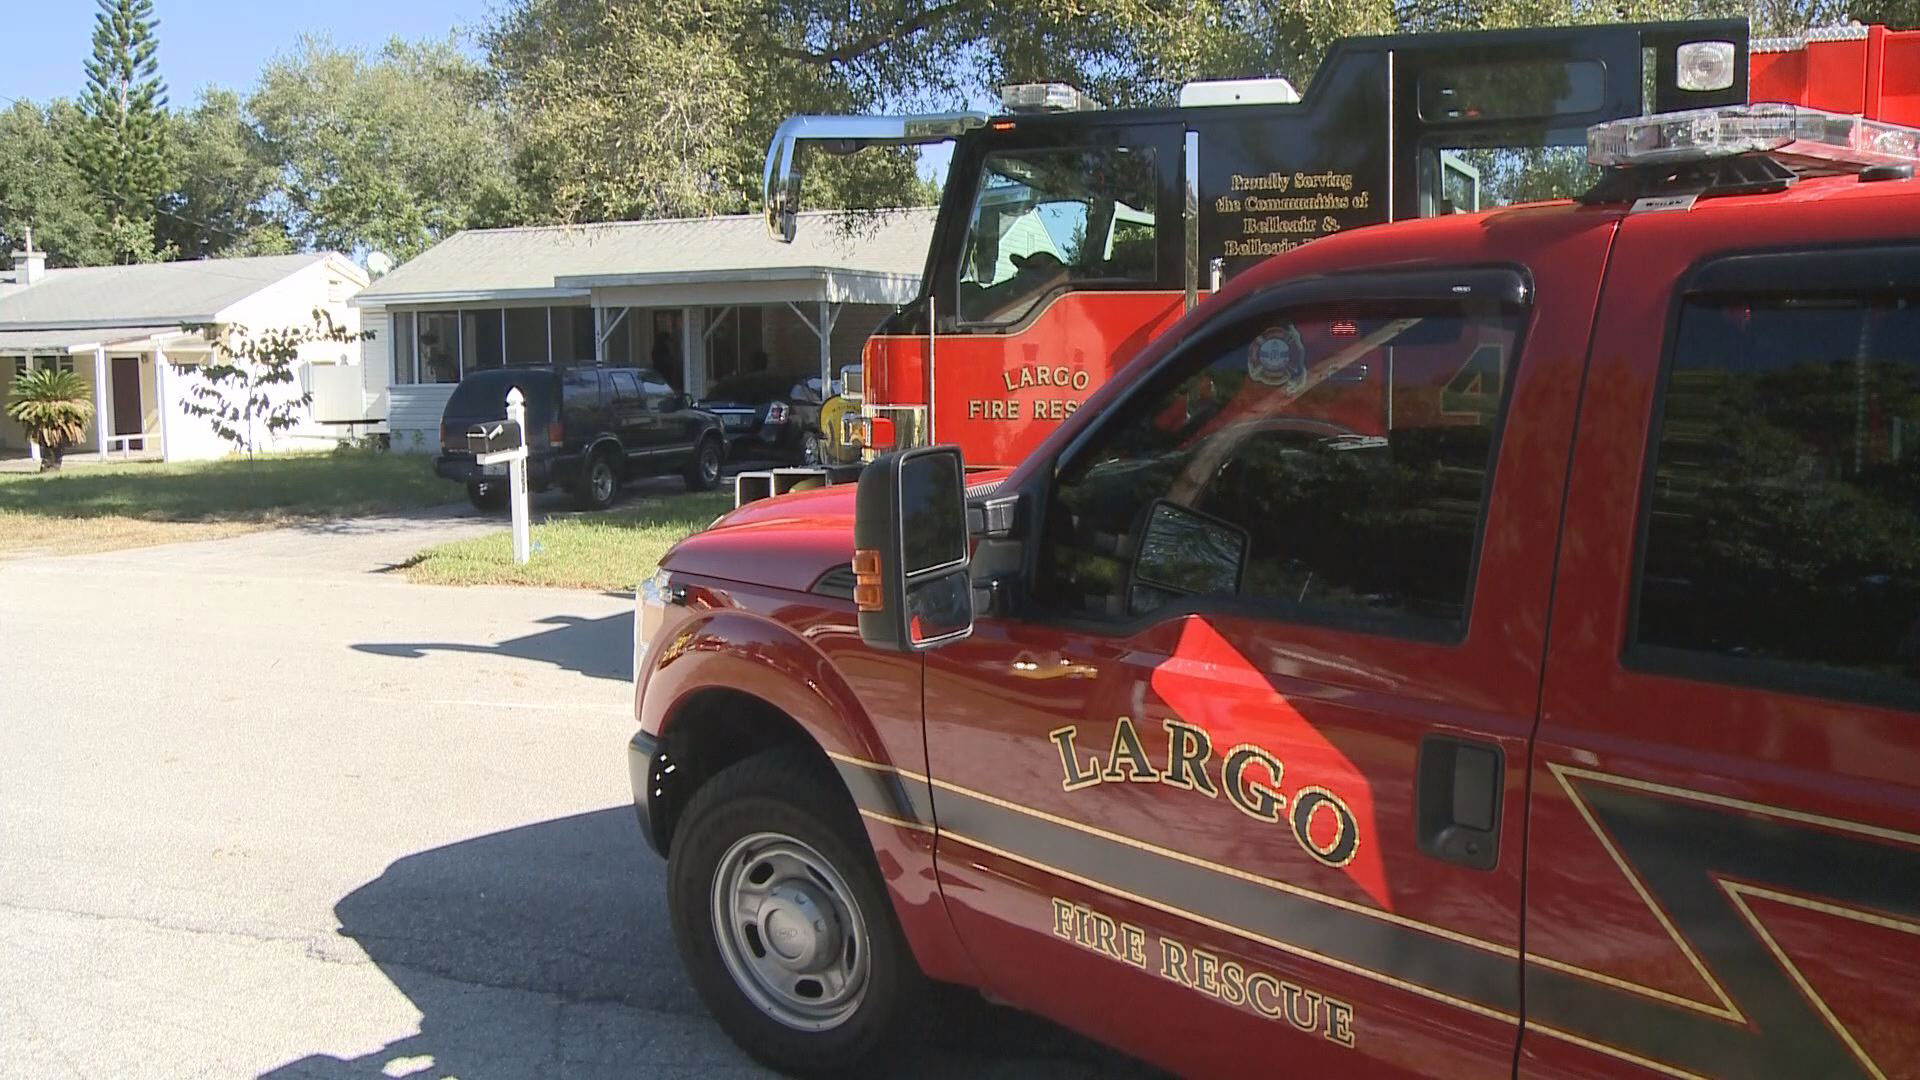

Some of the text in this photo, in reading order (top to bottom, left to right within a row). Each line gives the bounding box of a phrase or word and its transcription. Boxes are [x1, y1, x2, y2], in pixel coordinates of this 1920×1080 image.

[1231, 171, 1353, 192] Proudly Serving
[1216, 191, 1369, 212] the Communities of
[1243, 216, 1341, 234] Belleair &
[1003, 365, 1089, 392] LARGO
[968, 399, 1084, 420] FIRE RES
[1050, 716, 1360, 868] LARGO
[1051, 896, 1356, 1049] FIRE RESCUE
